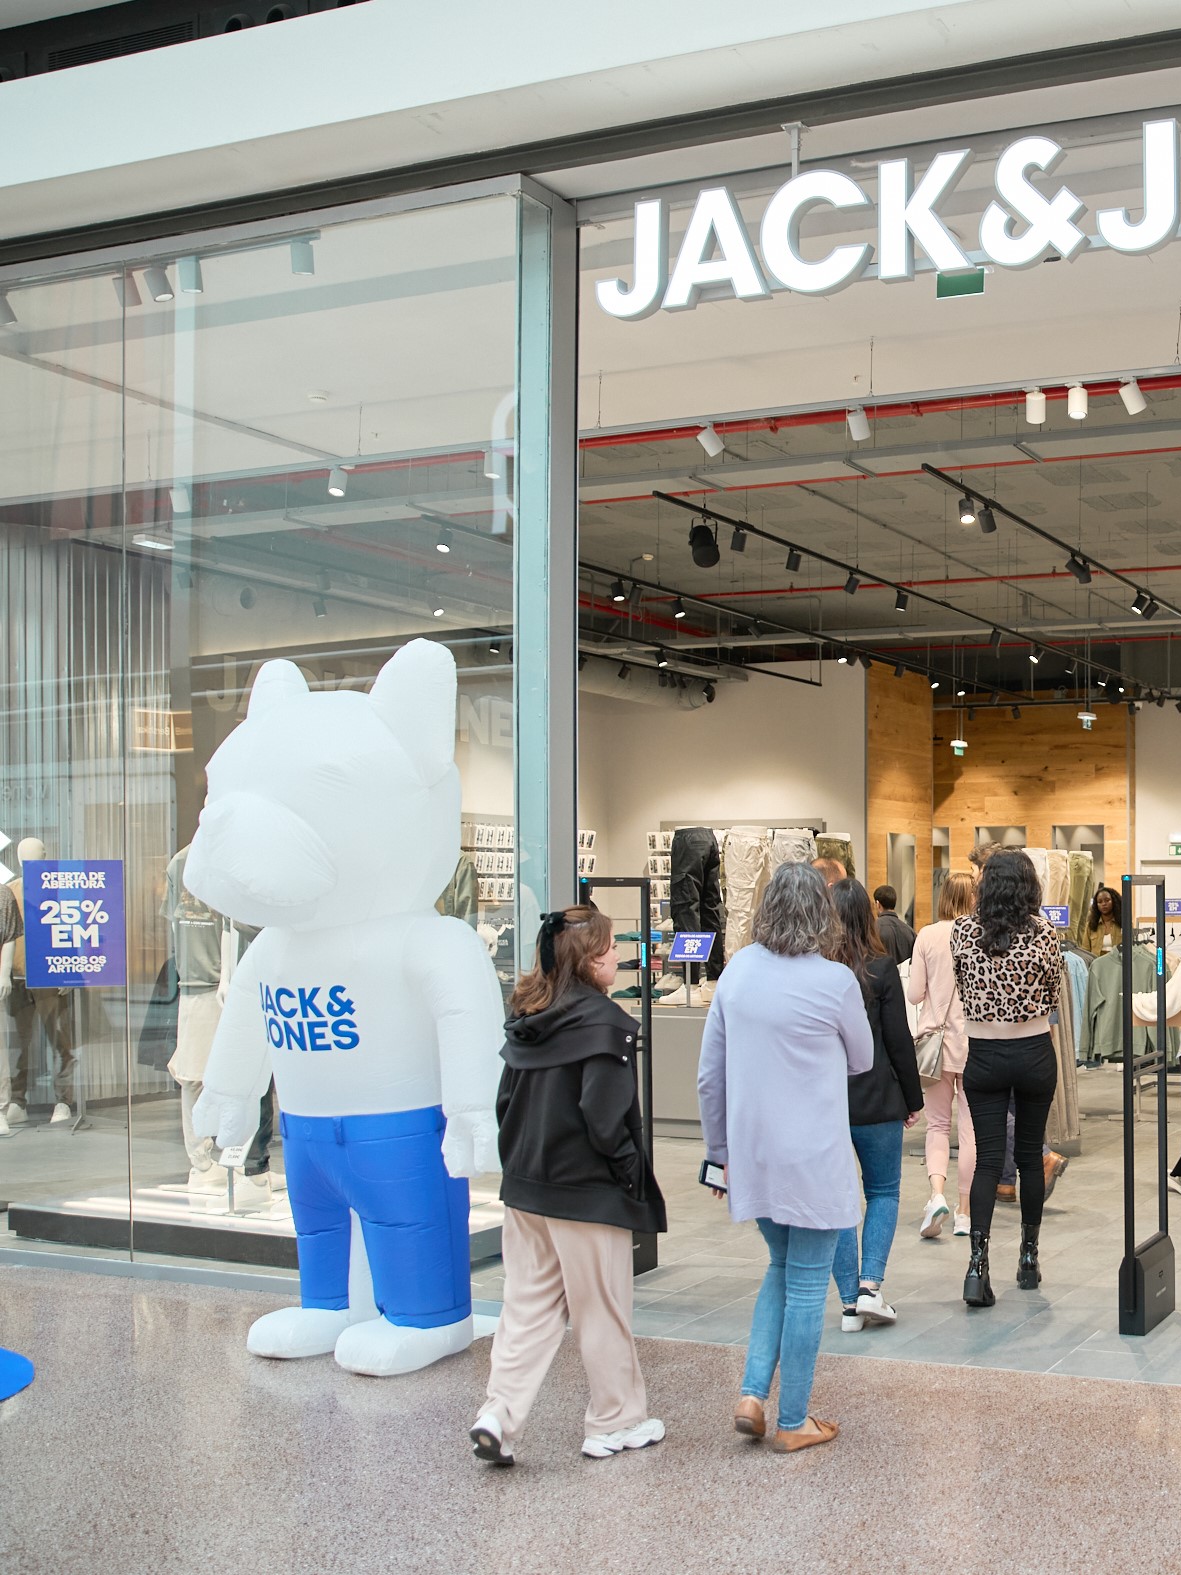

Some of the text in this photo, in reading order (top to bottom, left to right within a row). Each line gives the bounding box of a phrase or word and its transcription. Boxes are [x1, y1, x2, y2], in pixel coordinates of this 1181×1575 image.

[41, 871, 106, 881] OFERTA DE
[42, 880, 106, 889] ABERTURA
[40, 899, 109, 925] 25%
[51, 924, 100, 948] EM
[45, 955, 107, 966] TODOS OS
[259, 982, 356, 1019] ACK&
[264, 1014, 361, 1052] ONES
